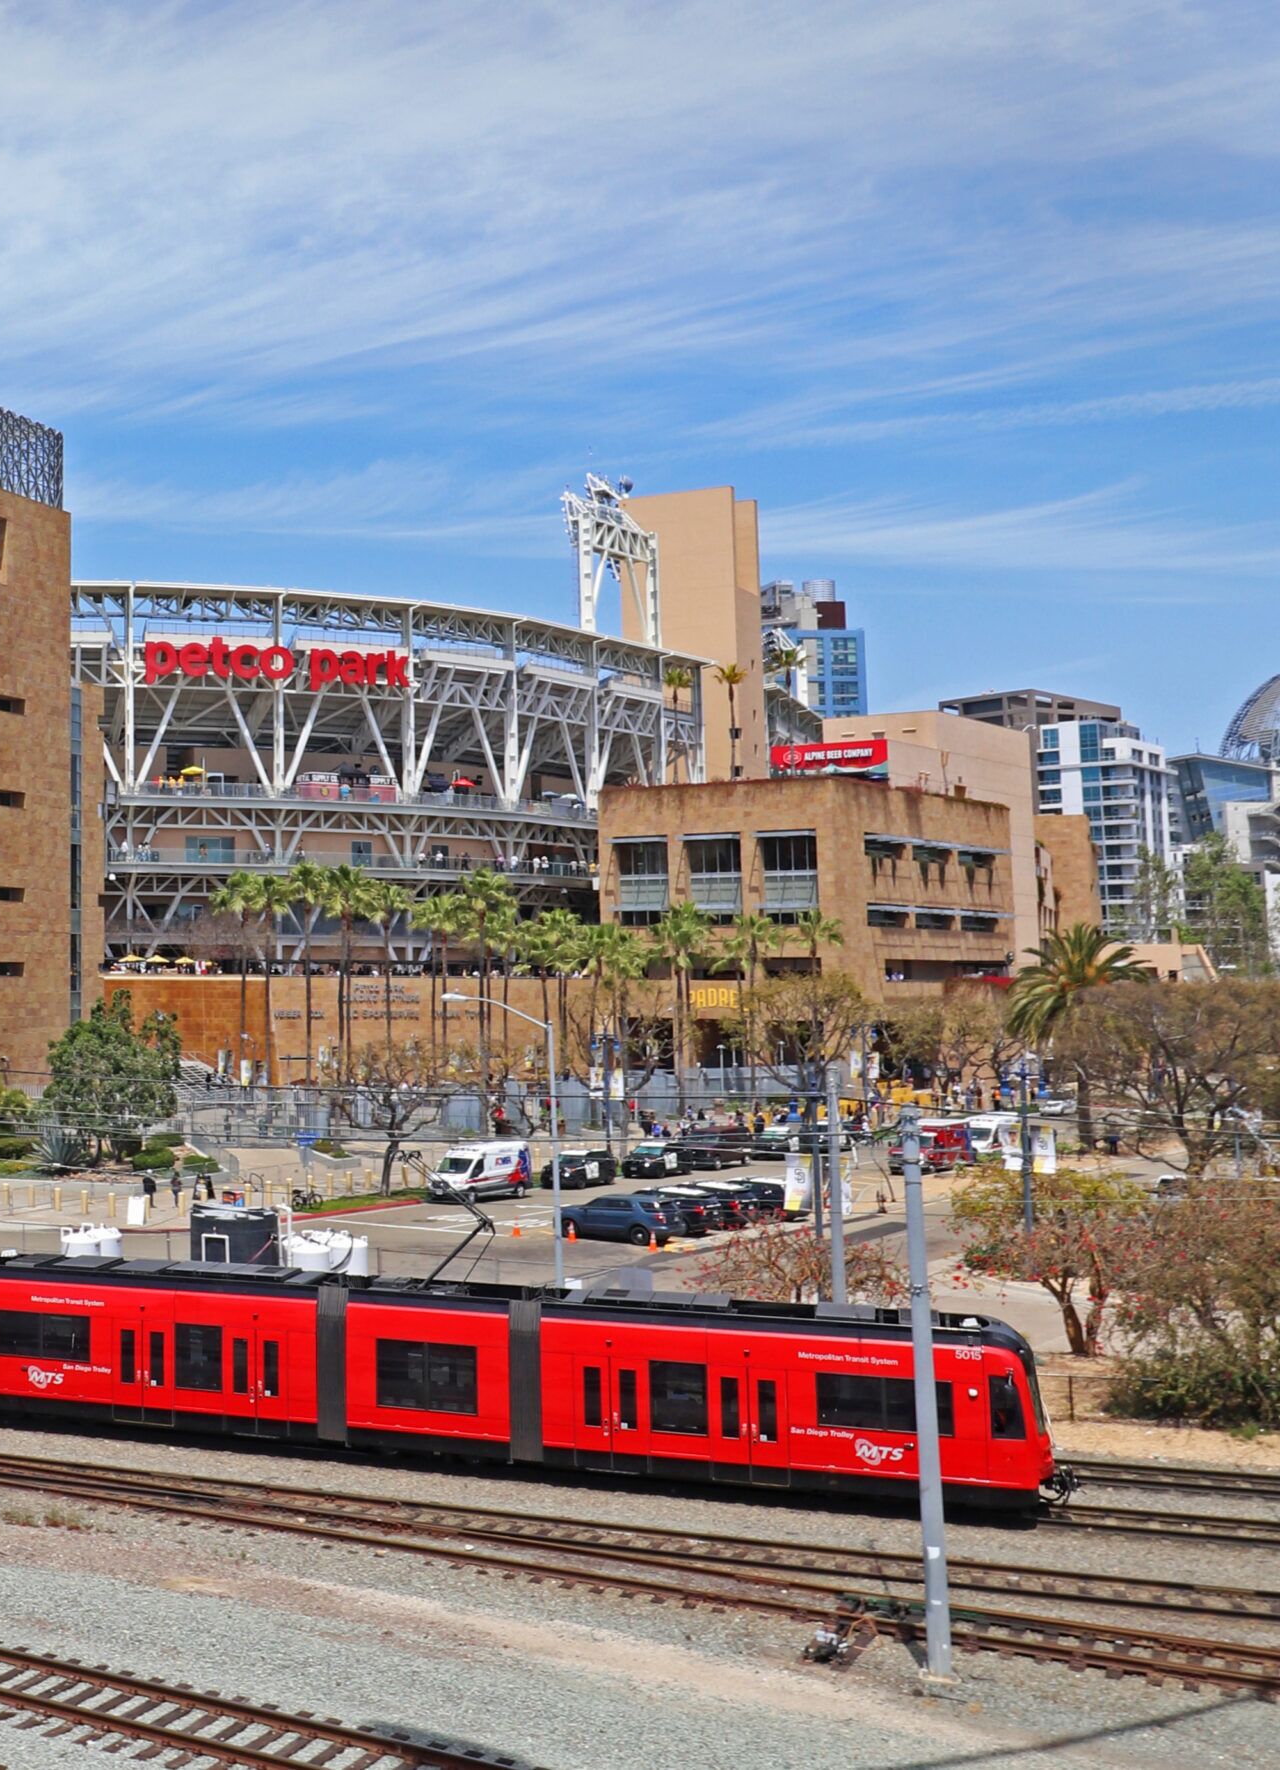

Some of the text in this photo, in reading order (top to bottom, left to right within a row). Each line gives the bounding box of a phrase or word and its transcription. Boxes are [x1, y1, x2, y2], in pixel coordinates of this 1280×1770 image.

[145, 636, 410, 691] petco park
[804, 751, 826, 761] ALPINE
[827, 750, 842, 760] BEER
[843, 748, 873, 758] COMPANY
[312, 774, 330, 783] SUPPLY
[371, 776, 391, 785] SUPPLY
[31, 1295, 105, 1307] Metropolitan Transit System
[798, 1351, 898, 1366] Metropolitan Transit System
[955, 1350, 982, 1361] 5015
[75, 1364, 91, 1372] Diego
[92, 1366, 111, 1375] Trolley
[28, 1370, 64, 1386] MTS
[790, 1426, 854, 1440] San Diego Trolley
[855, 1444, 904, 1462] MTS
